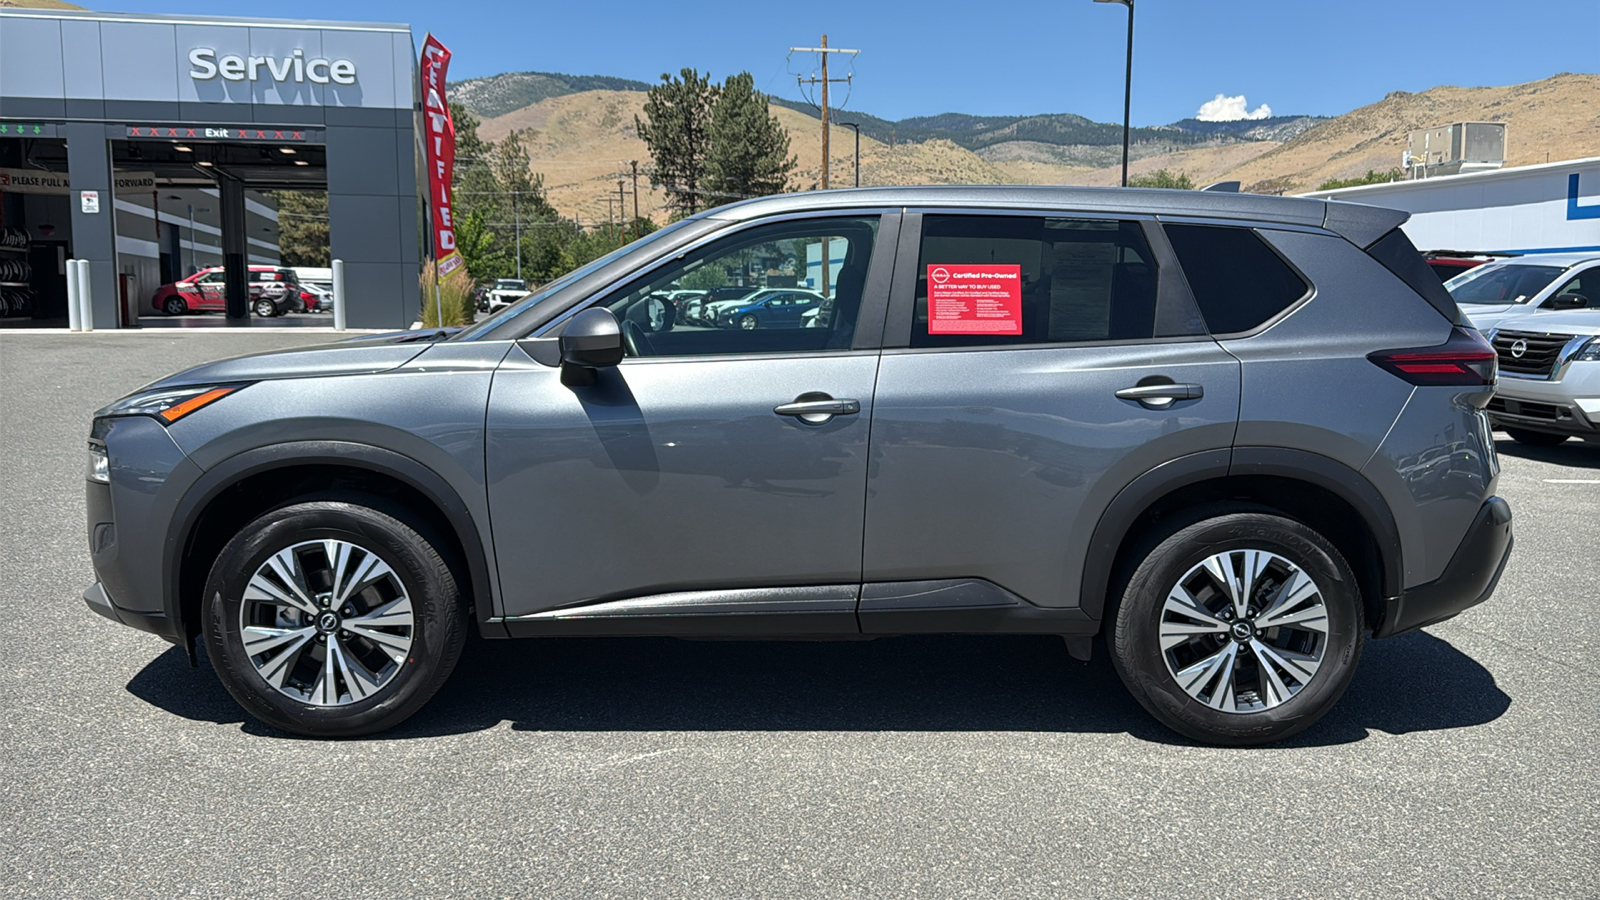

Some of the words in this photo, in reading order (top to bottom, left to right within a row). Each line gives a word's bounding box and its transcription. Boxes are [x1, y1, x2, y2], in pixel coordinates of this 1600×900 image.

[188, 47, 356, 84] Service
[205, 128, 229, 138] Exit
[11, 176, 40, 186] PLEASE
[41, 178, 61, 187] PULL
[114, 178, 153, 188] FORWARD
